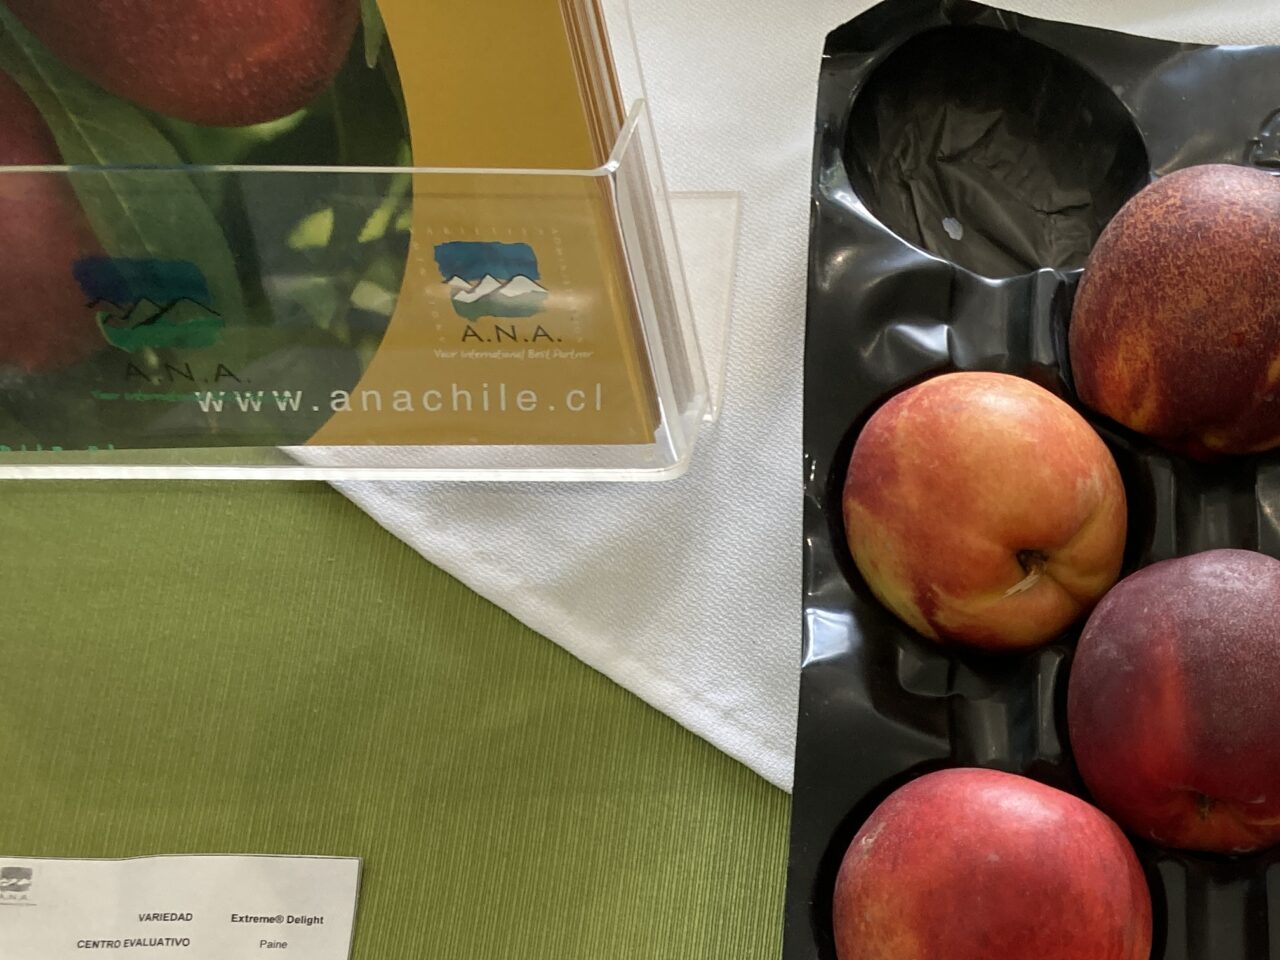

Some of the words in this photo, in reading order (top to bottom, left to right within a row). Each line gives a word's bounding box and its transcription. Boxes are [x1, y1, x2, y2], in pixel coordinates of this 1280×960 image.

[461, 324, 563, 343] A.N.A.
[125, 362, 251, 383] A.N.A.
[194, 383, 603, 413] www.anachile.cl
[138, 912, 193, 922] VARIEDAD
[286, 915, 324, 925] Delight
[77, 940, 121, 949] CENTRO
[123, 938, 191, 947] EVALUATIVO
[259, 939, 288, 949] Paine
